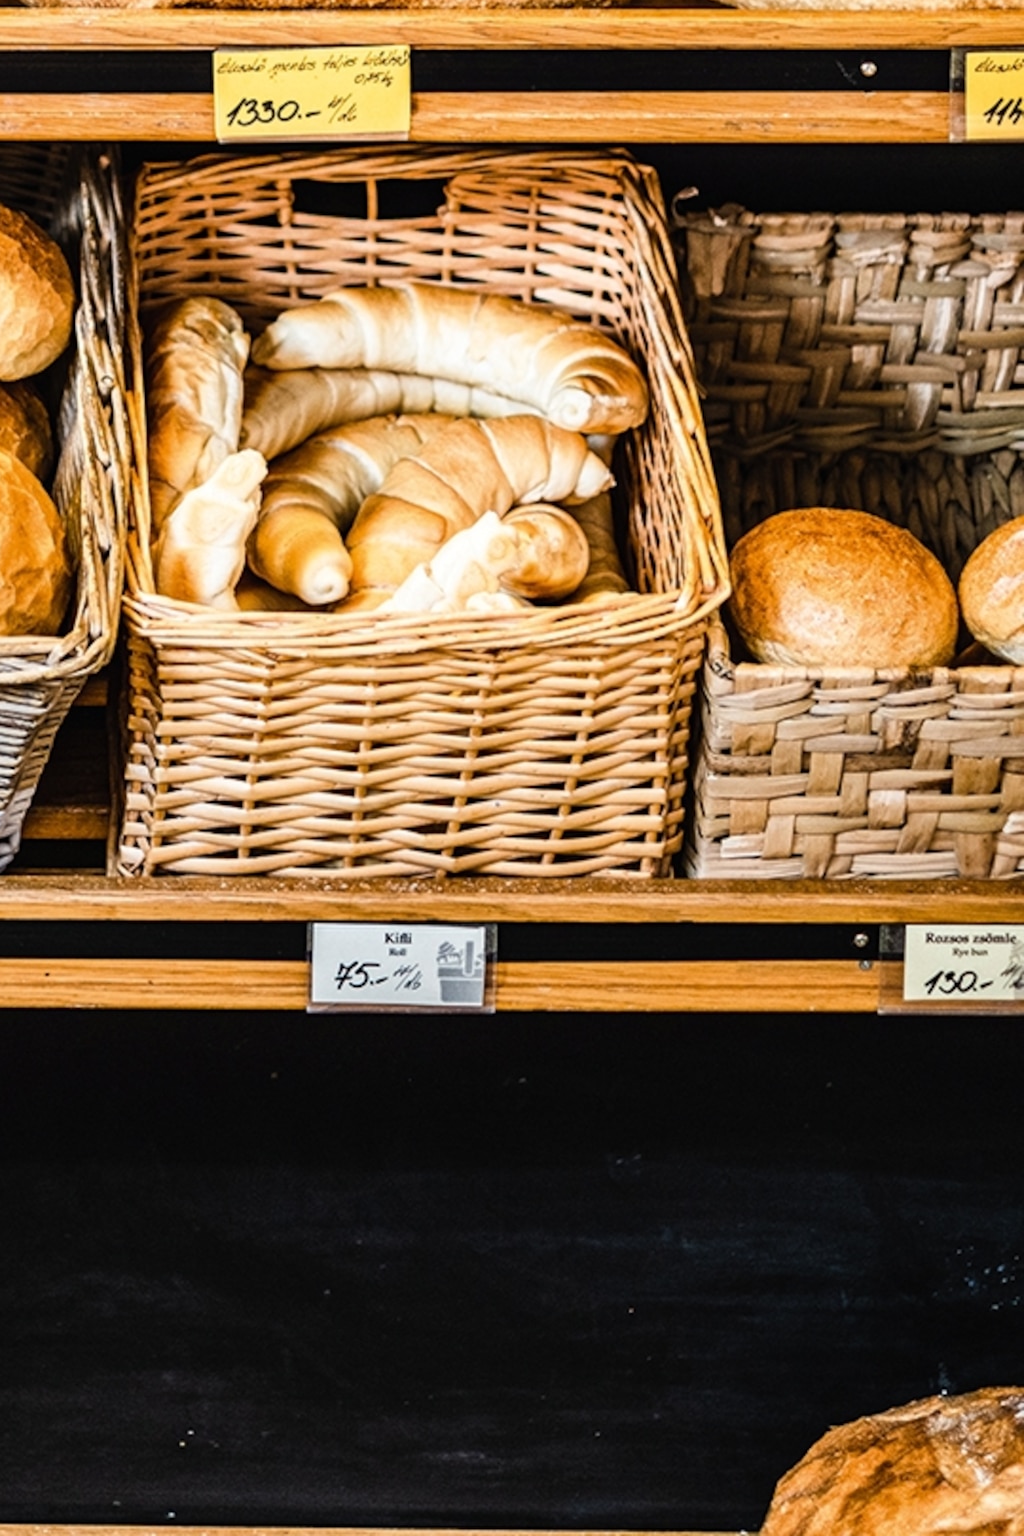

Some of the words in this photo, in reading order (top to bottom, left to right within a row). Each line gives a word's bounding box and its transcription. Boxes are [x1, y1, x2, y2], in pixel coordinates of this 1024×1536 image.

[384, 932, 413, 945] Kifli
[925, 932, 970, 944] Rozsos
[972, 932, 1018, 944] zsömle
[952, 948, 969, 958] Rye
[971, 947, 989, 957] bun
